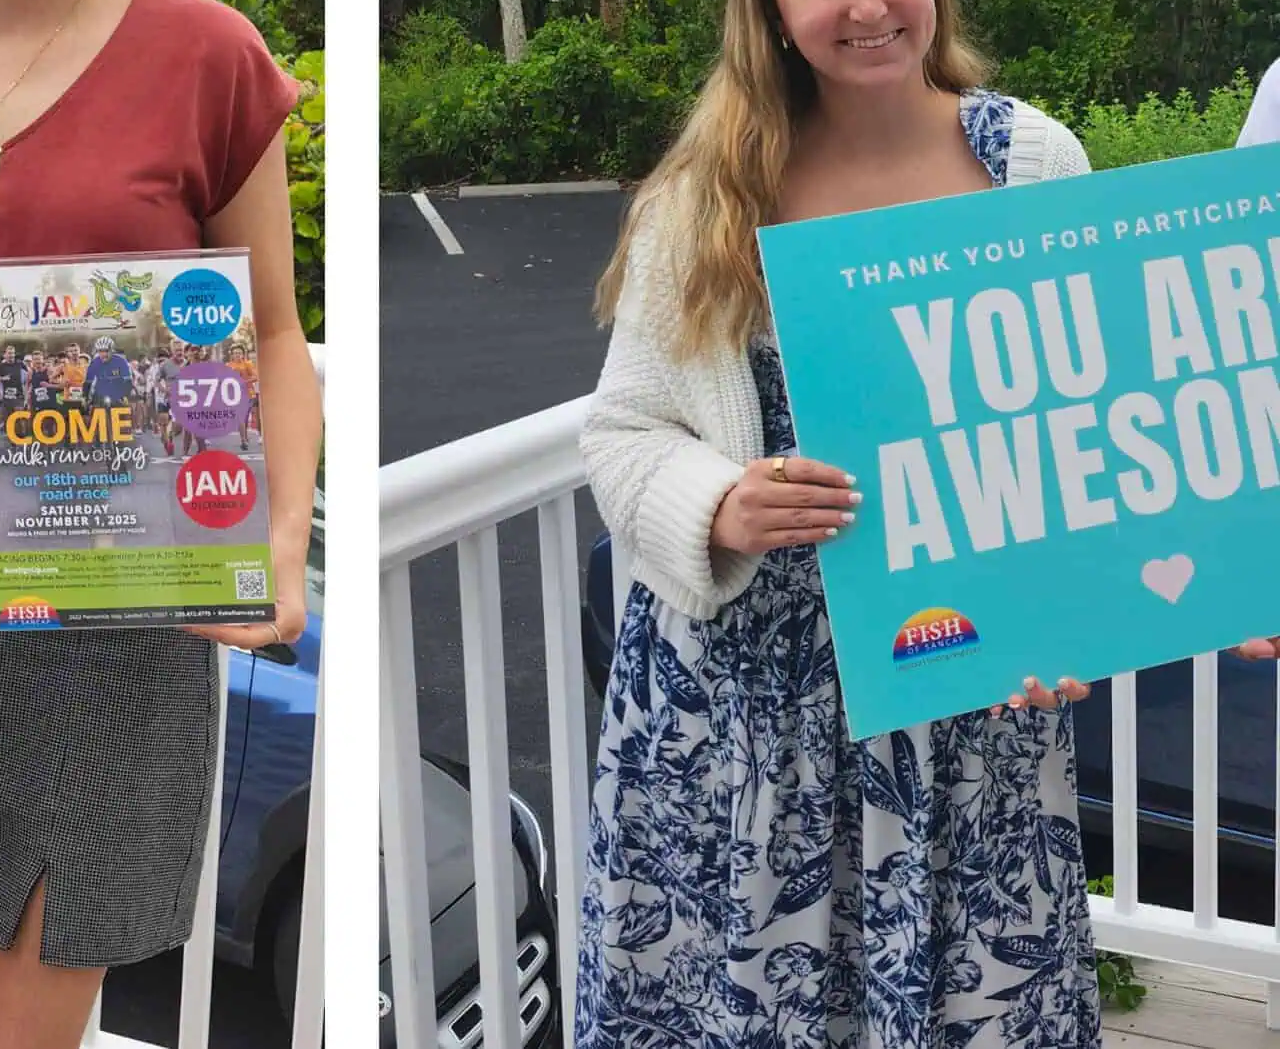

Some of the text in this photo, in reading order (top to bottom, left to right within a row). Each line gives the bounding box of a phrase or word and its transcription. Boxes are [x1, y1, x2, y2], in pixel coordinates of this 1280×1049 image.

[840, 191, 1280, 289] THANK YOU FOR PARTICIPA
[30, 294, 89, 326] JAM
[186, 294, 216, 304] ONLY
[170, 304, 237, 326] 5/10K
[890, 237, 1280, 427] YOU AR
[177, 377, 242, 408] 570
[5, 407, 134, 445] COME
[186, 410, 236, 421] RUNNERS
[49, 448, 90, 464] run
[92, 449, 112, 462] OR
[111, 440, 148, 470] jog
[14, 470, 132, 487] our 18th annual
[182, 469, 249, 504] JAM
[39, 487, 73, 501] road
[40, 503, 110, 516] SATURDAY
[15, 514, 137, 528] NOVEMBER 1, 2025
[7, 605, 50, 619] FISH
[904, 617, 965, 647] FISH
[907, 635, 965, 655] OF SANCAP
